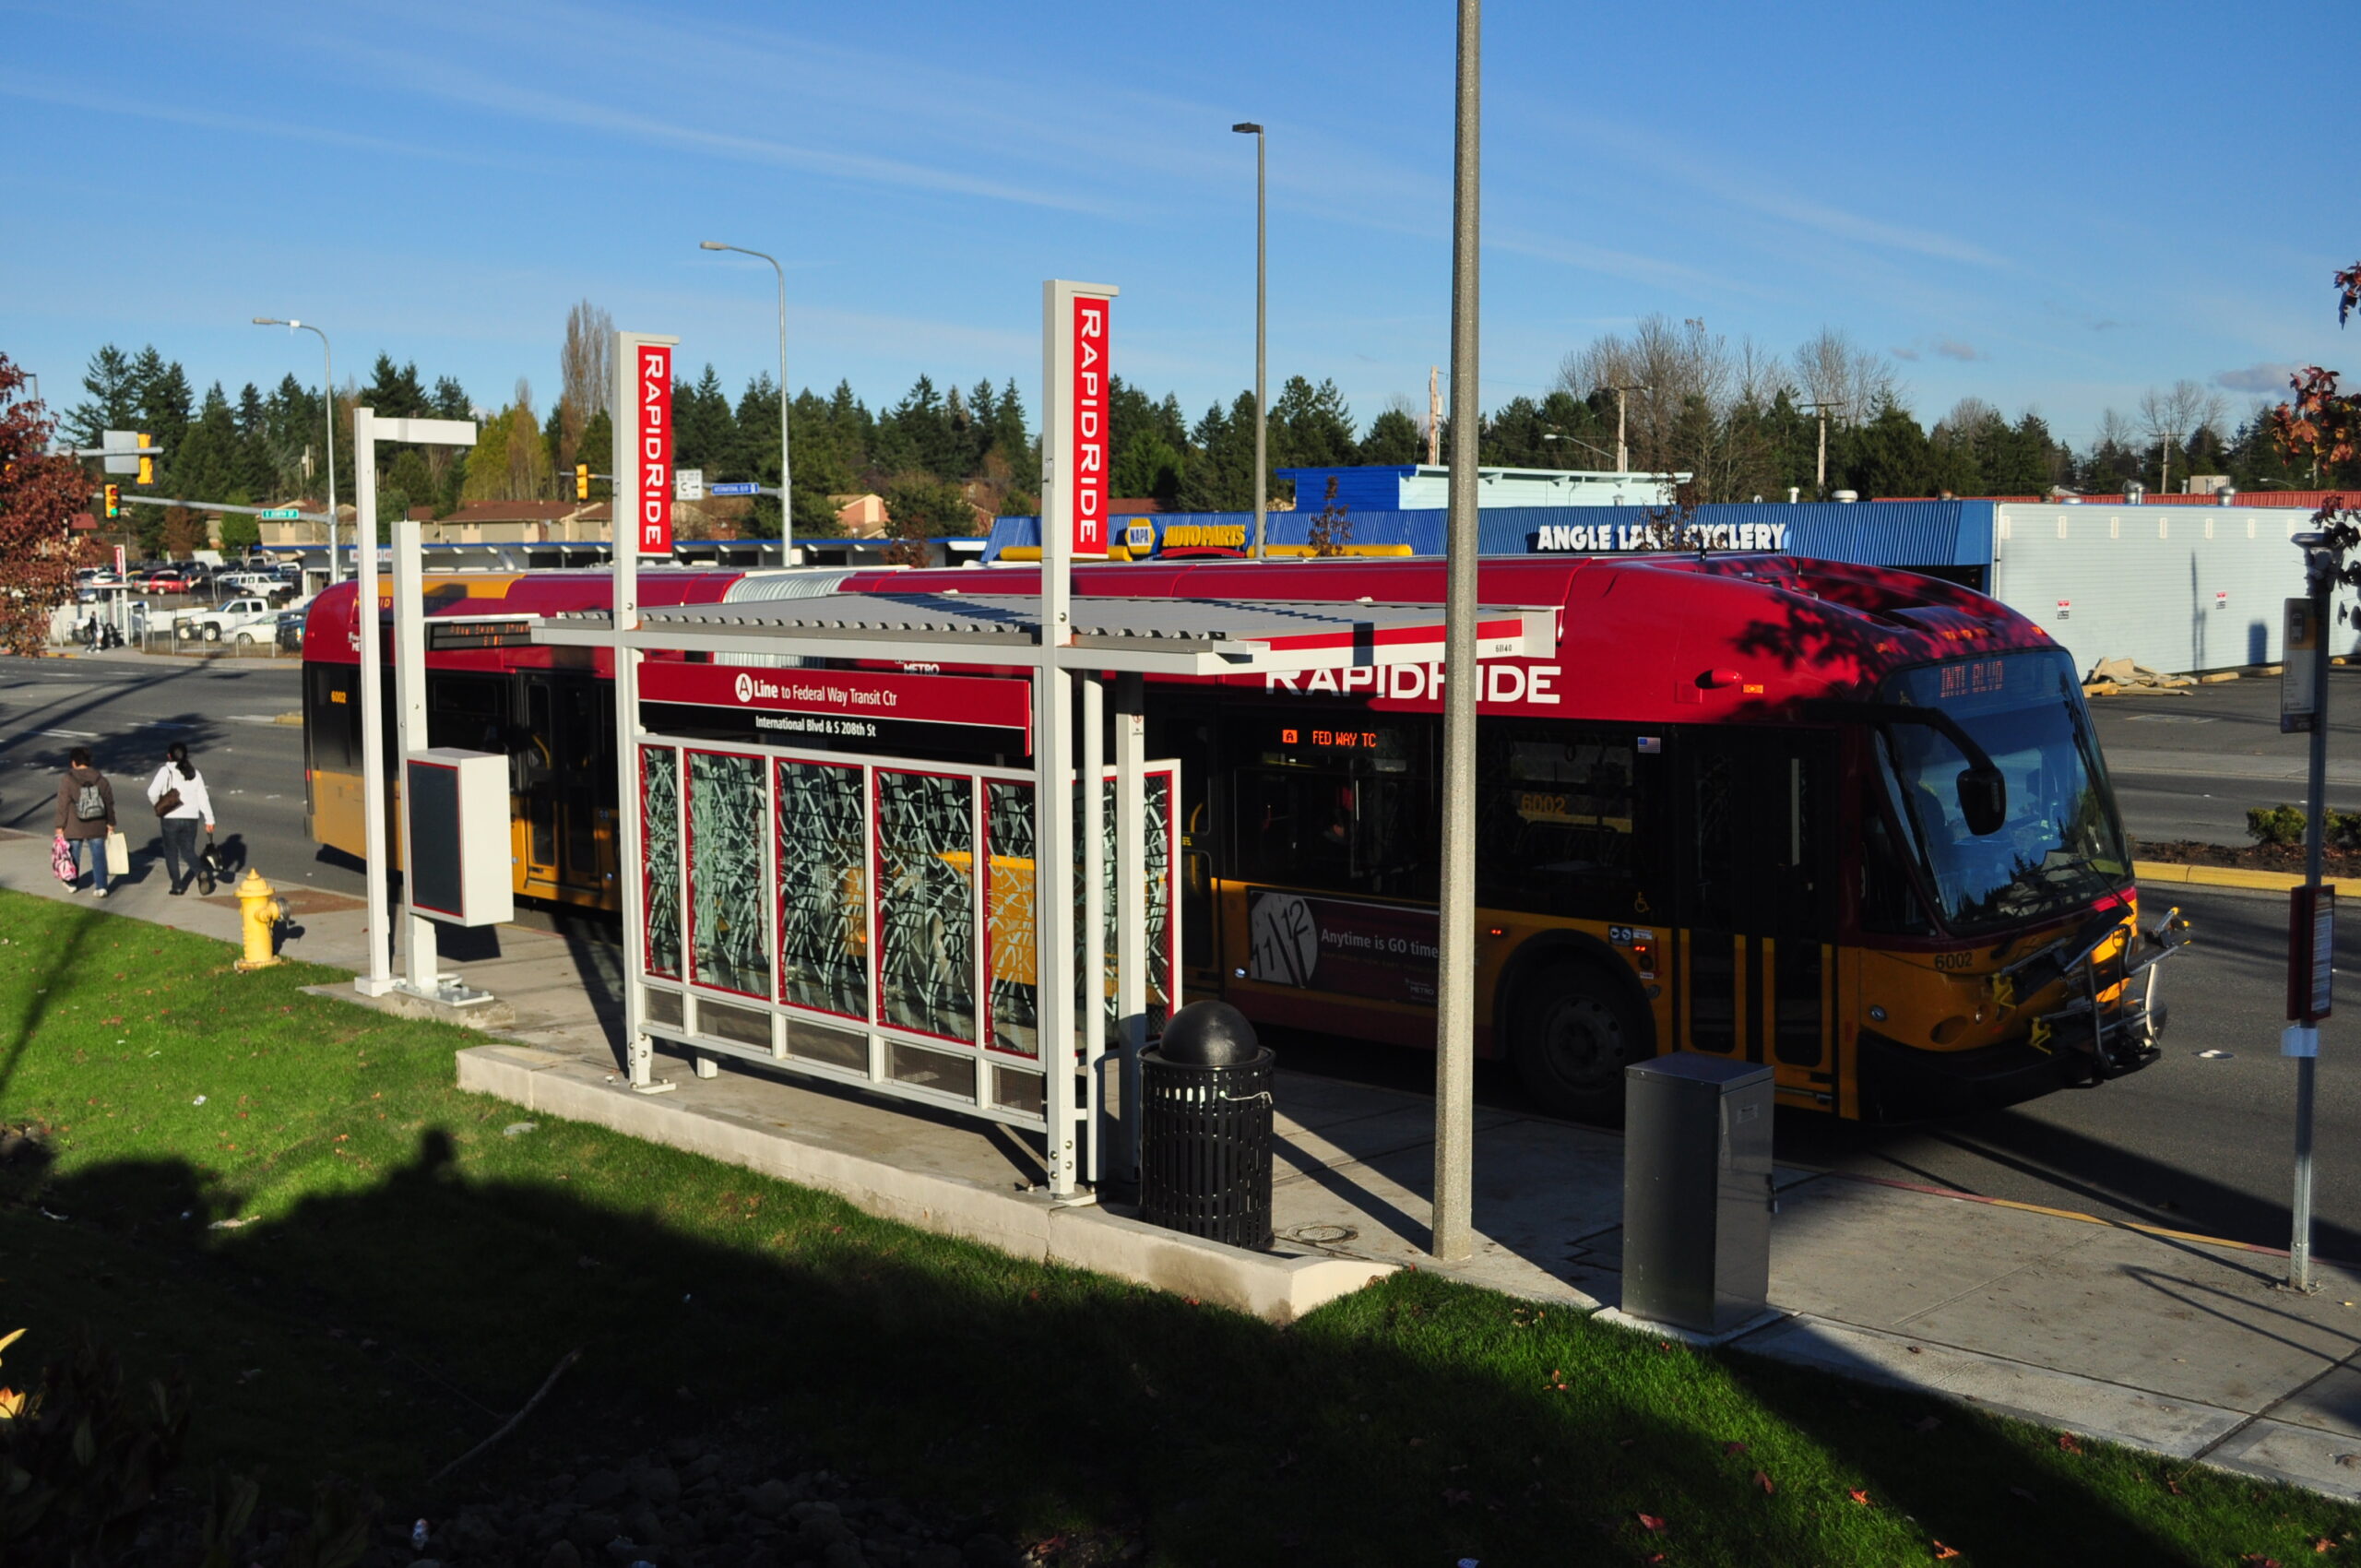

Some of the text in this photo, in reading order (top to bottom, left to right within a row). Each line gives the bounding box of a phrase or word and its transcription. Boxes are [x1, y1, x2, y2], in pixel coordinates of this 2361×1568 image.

[1080, 308, 1101, 543] RAPIDRIDE
[645, 354, 664, 544] RAPIDRIDE
[1130, 528, 1149, 544] NAPA
[1162, 525, 1246, 547] AUTO PARTS
[1537, 524, 1612, 551] ANGLE
[904, 663, 940, 675] METRO
[753, 679, 778, 698] Line
[781, 685, 790, 699] to
[793, 684, 825, 701] Federal
[827, 686, 848, 707] Way
[849, 688, 881, 706] Transit
[883, 690, 897, 707] Ctr
[755, 715, 876, 737] International Blvd & S 208th St
[1312, 730, 1332, 745] FED
[1335, 731, 1358, 746] WAY
[1361, 732, 1377, 748] TC
[1321, 928, 1371, 949] Anytime
[1375, 935, 1385, 951] is
[1388, 937, 1407, 955] GO
[1934, 951, 1973, 969] 6002
